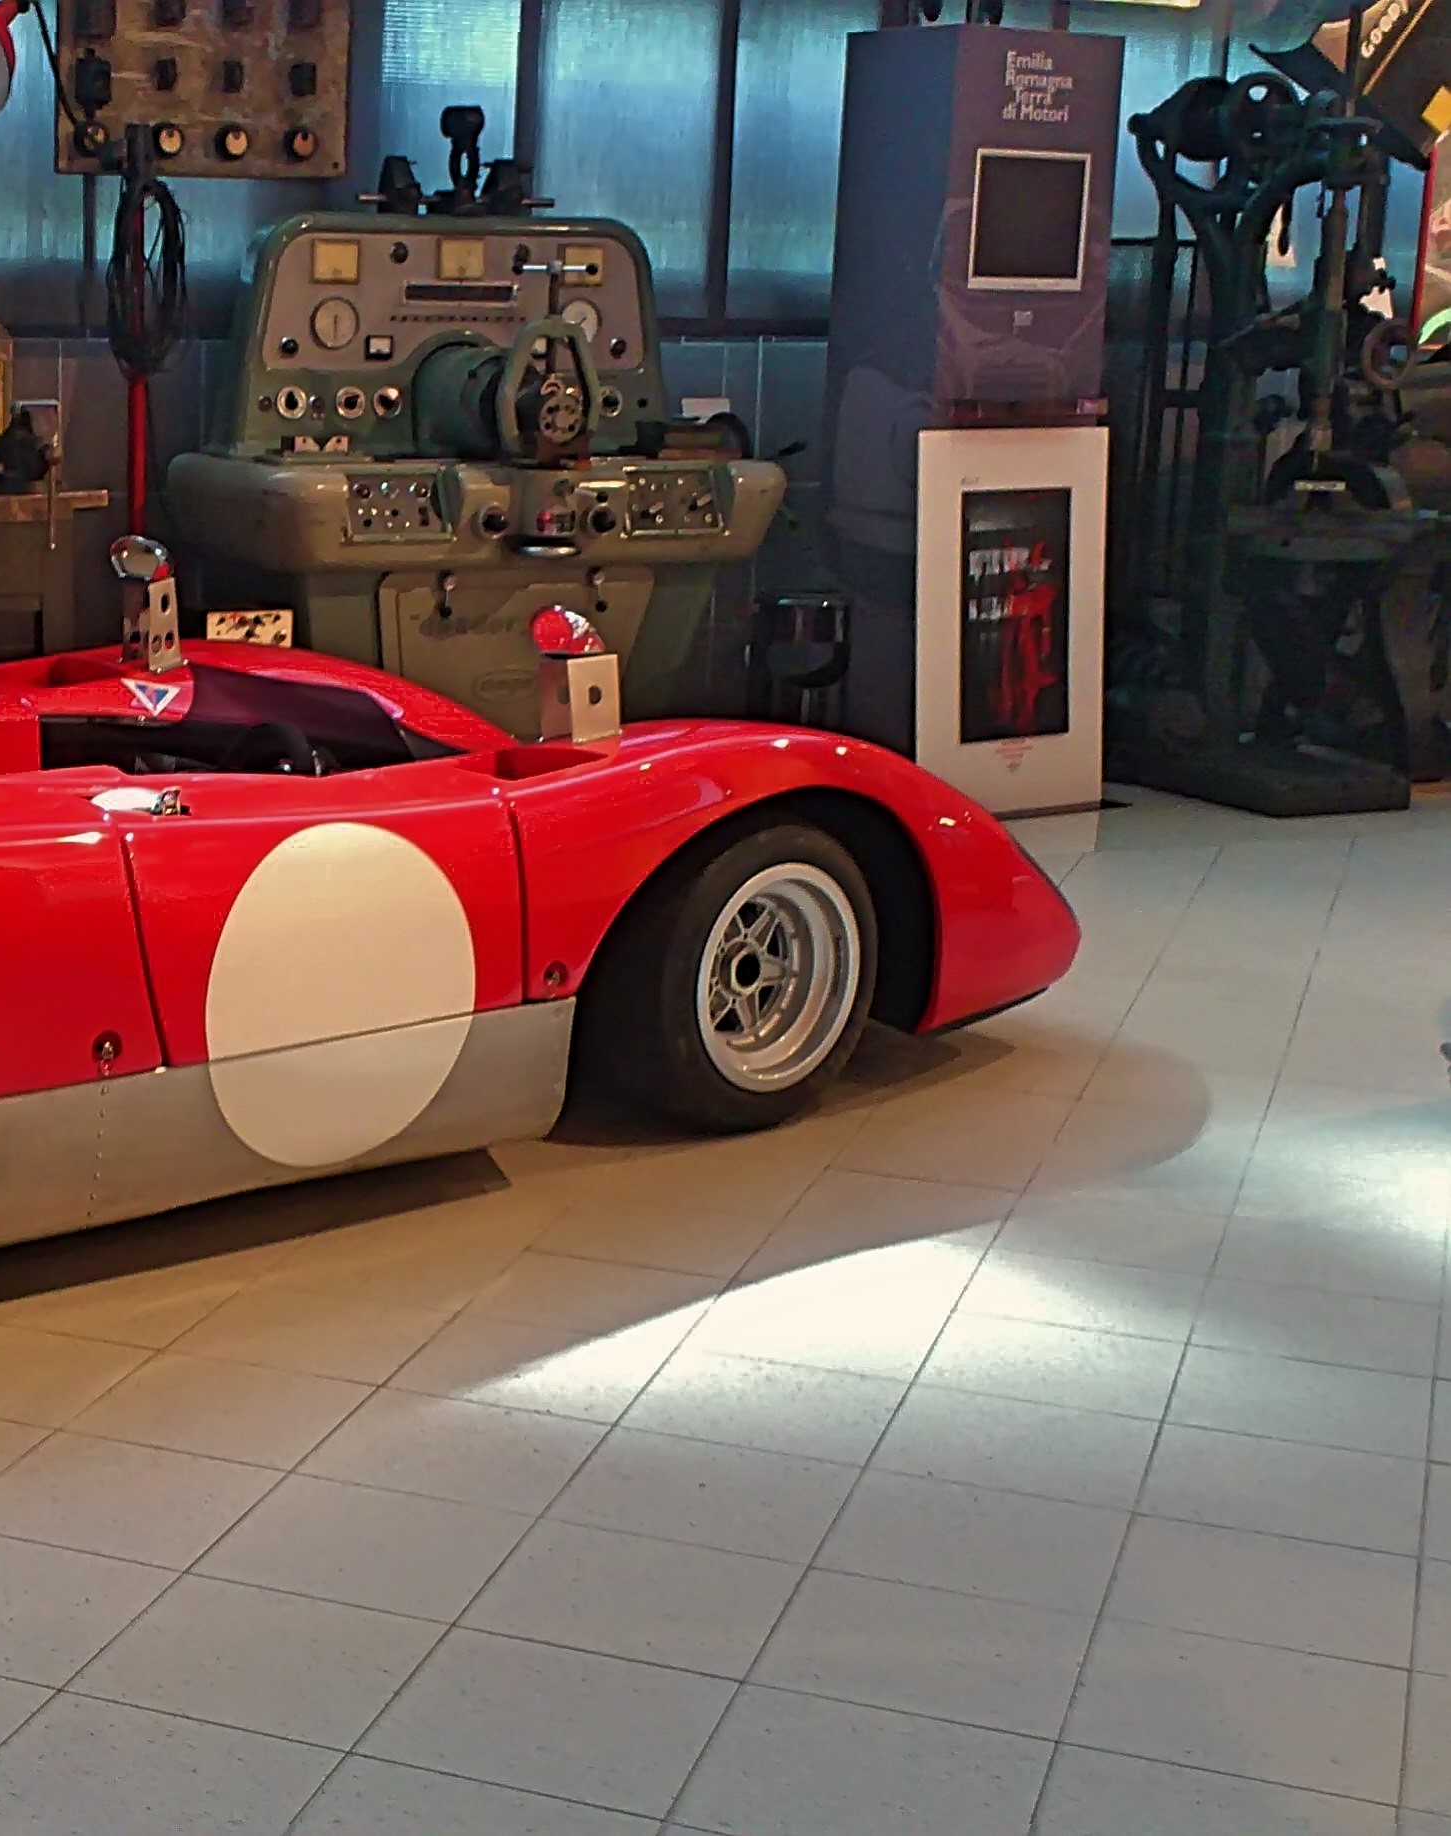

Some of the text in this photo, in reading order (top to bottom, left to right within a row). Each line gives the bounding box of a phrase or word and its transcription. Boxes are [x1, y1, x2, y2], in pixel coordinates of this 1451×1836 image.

[1006, 50, 1053, 71] Emilia
[1005, 71, 1074, 93] Romagna
[1014, 86, 1053, 104] Terra
[1002, 102, 1070, 122] di Motori
